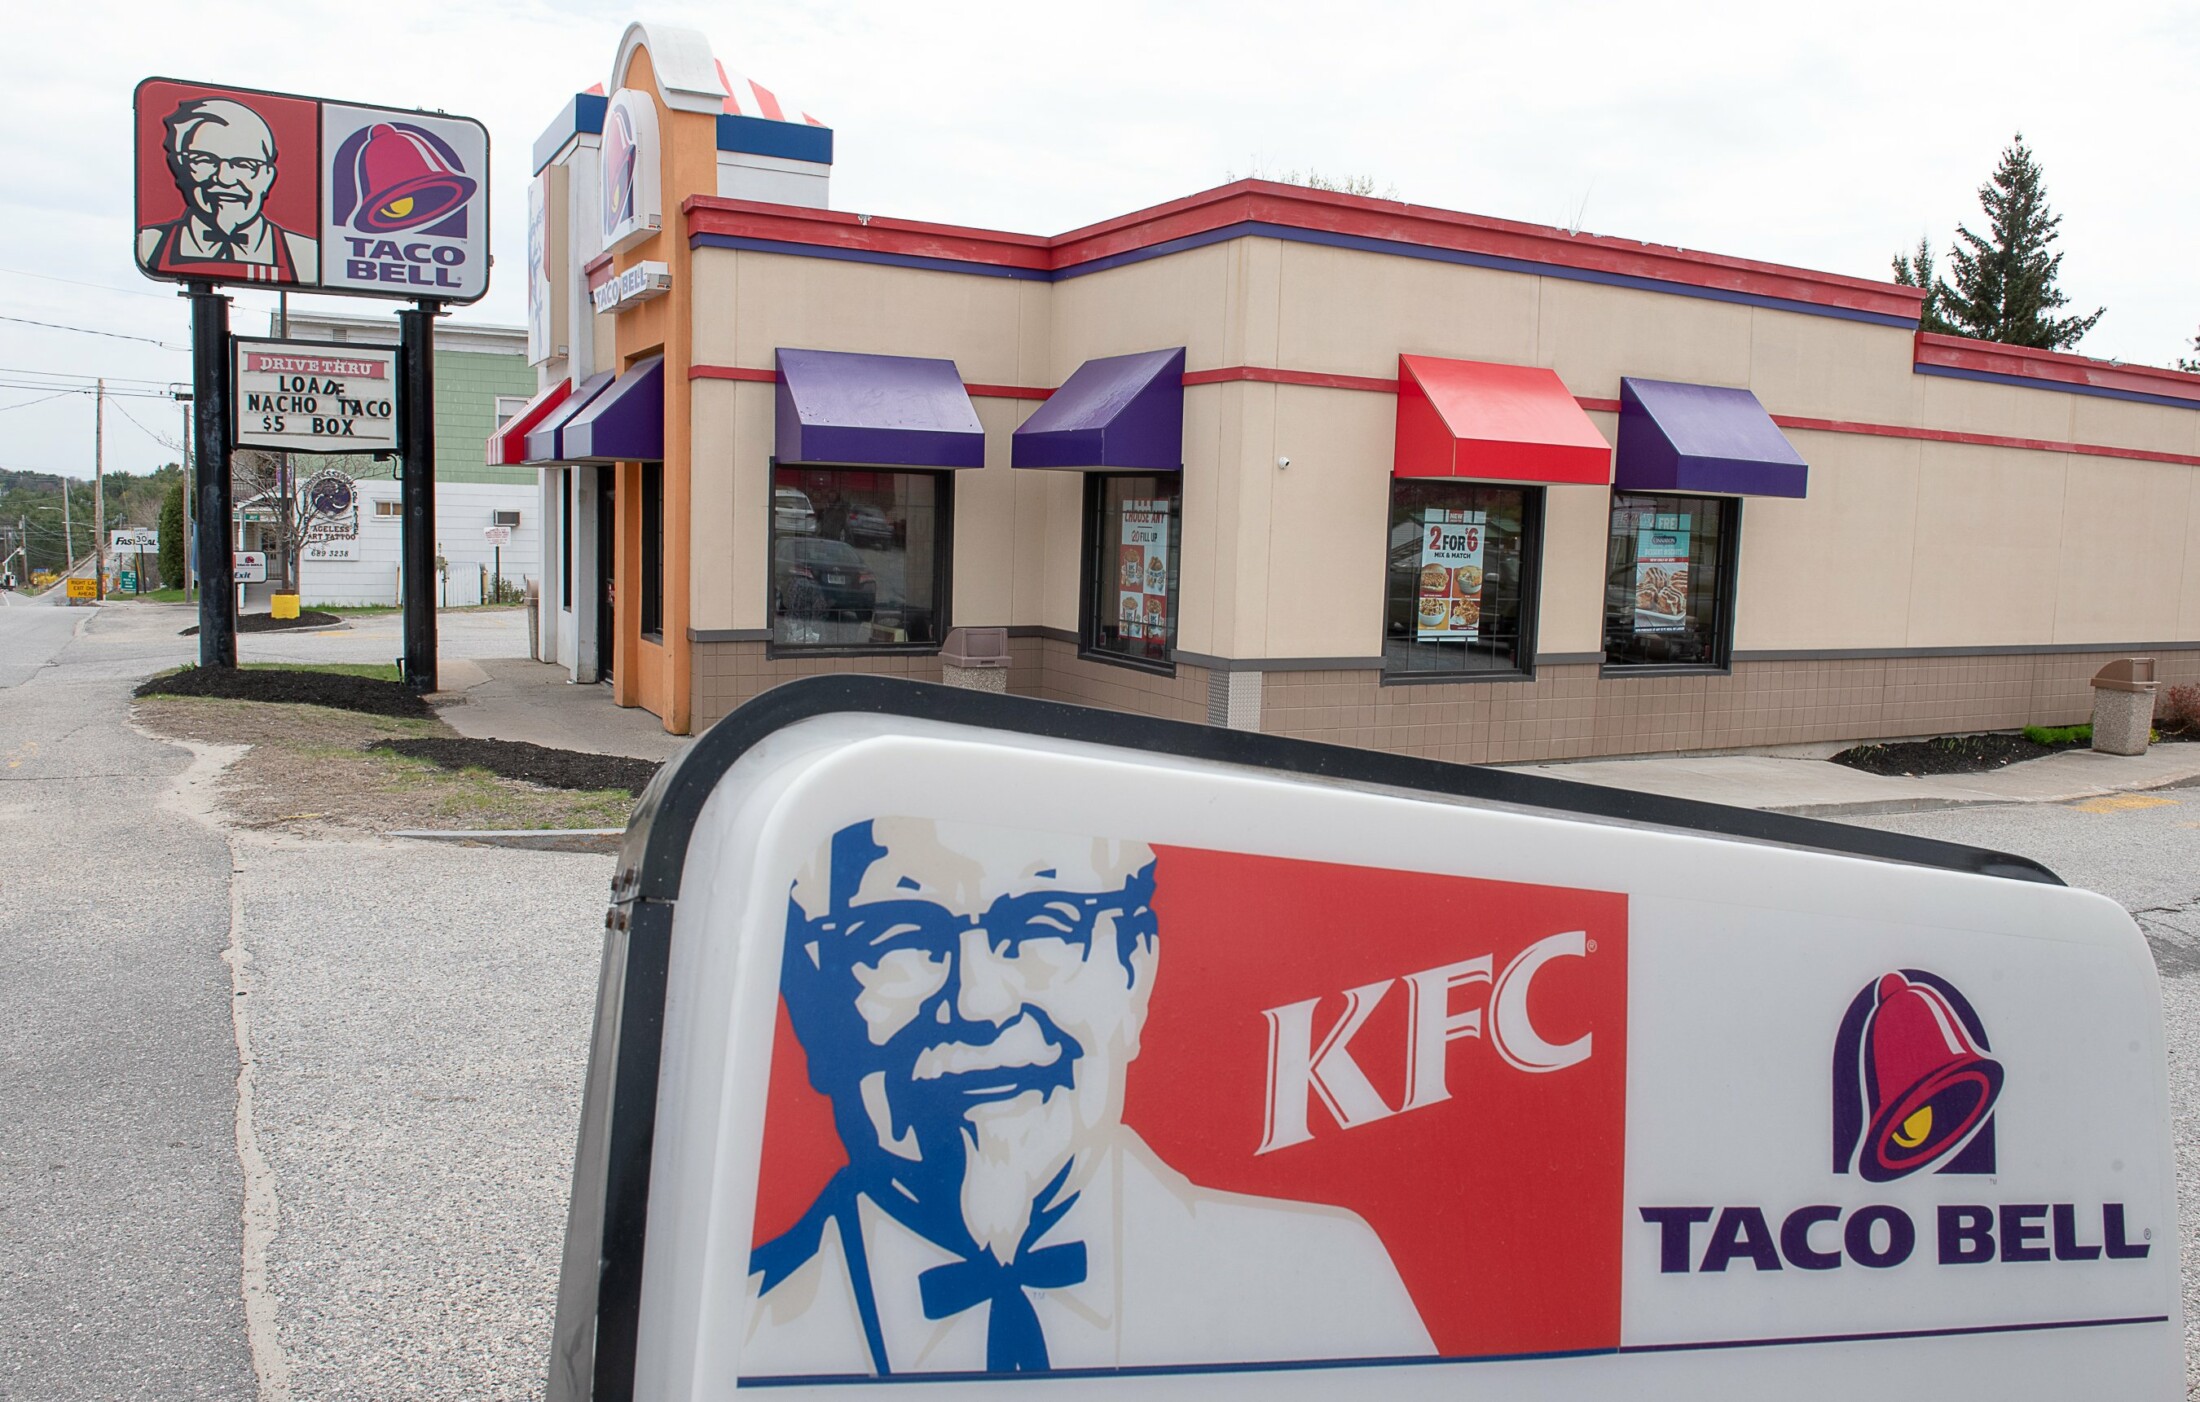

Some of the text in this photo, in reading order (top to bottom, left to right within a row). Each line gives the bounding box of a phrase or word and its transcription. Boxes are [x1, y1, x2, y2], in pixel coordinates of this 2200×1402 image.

[344, 236, 466, 266] TACO
[347, 259, 462, 288] BELL
[596, 267, 647, 309] TACO BELL
[260, 357, 372, 375] DRIVE THRU
[248, 394, 392, 417] NACHO TACO
[263, 416, 354, 436] $5 BOX
[115, 536, 156, 546] FASAL
[312, 525, 350, 533] AGELESS
[1429, 525, 1442, 550] 2
[1442, 535, 1466, 551] FOR
[311, 549, 349, 557] 689 3238
[1253, 930, 1593, 1157] KFC
[1639, 1203, 2150, 1273] TACO BELL
